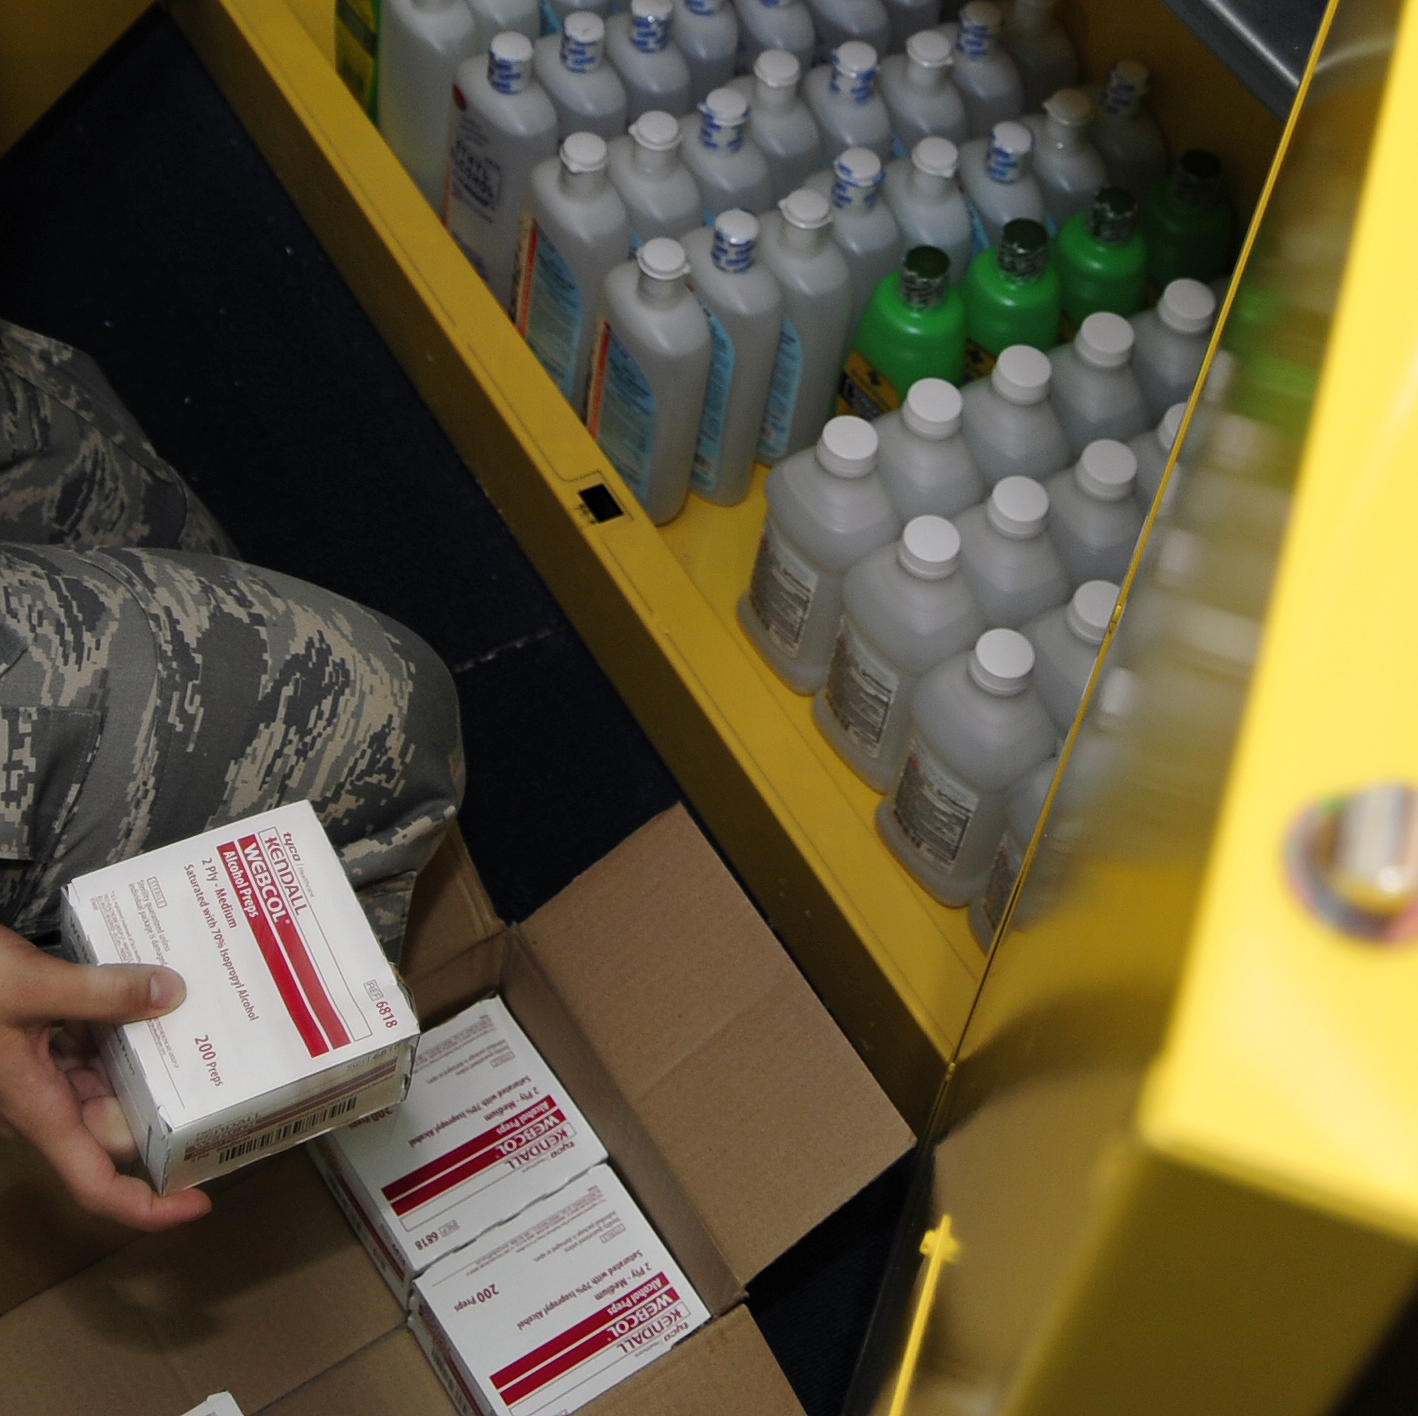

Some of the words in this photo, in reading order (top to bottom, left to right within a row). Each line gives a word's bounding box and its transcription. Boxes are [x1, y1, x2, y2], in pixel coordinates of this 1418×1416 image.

[280, 830, 302, 863] tyco
[200, 856, 212, 866] 2
[202, 864, 220, 883] Ply
[182, 863, 210, 908] Saturated
[221, 848, 249, 889] Alcohol
[236, 886, 261, 919] Preps
[263, 834, 308, 915] KENDALL
[201, 906, 218, 929] with
[213, 887, 240, 929] Medium
[211, 928, 226, 948] 70%
[217, 947, 244, 990] Isopropyl
[236, 988, 258, 1021] Alcohol
[375, 999, 398, 1029] 6818
[193, 1033, 216, 1062] 200
[202, 1060, 225, 1089] Preps
[483, 1099, 516, 1123] Medium
[518, 1100, 550, 1124] Alcohol
[494, 1116, 520, 1136] Preps
[503, 1127, 568, 1172] KENDALL
[414, 1231, 439, 1251] 6818
[606, 1248, 643, 1275] Saturated
[629, 1264, 645, 1280] Ply
[590, 1270, 609, 1285] with
[593, 1277, 628, 1302] Medium
[629, 1276, 663, 1303] Alcohol
[453, 1295, 477, 1312] Preps
[477, 1283, 499, 1303] 200
[540, 1287, 576, 1314] Isopropyl
[604, 1294, 632, 1317] Preps
[516, 1309, 544, 1330] Alcohol
[615, 1308, 683, 1355] KENDALL
